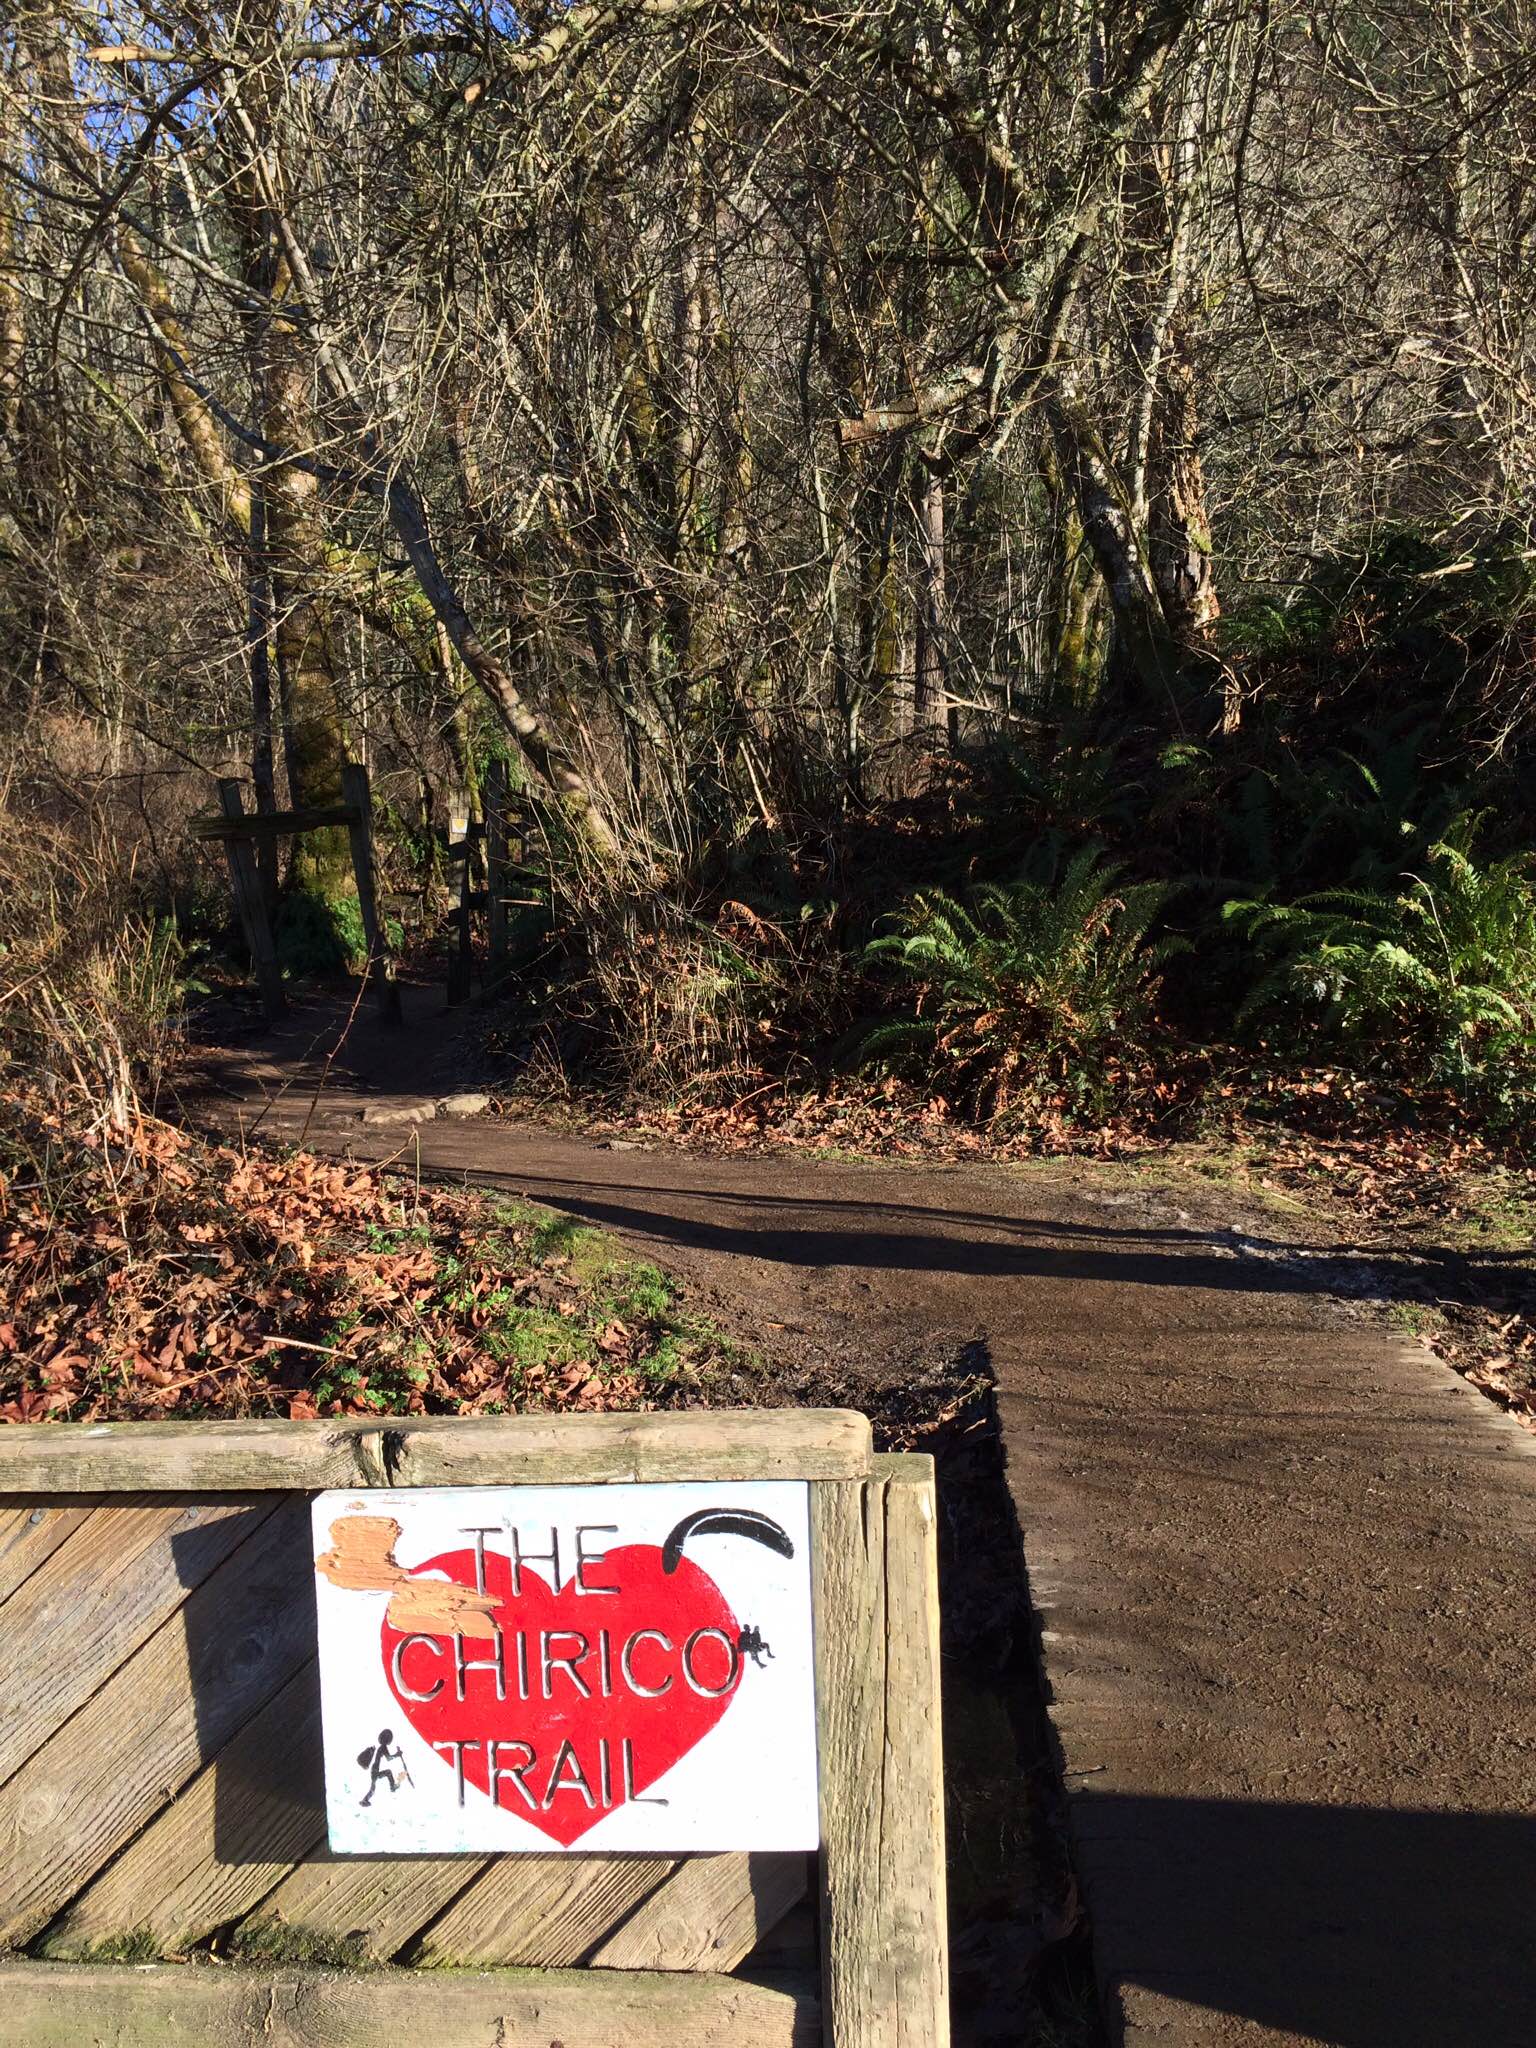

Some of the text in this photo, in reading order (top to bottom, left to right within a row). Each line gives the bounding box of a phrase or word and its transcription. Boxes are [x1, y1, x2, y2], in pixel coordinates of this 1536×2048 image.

[458, 1525, 622, 1597] THE
[391, 1627, 740, 1702] CHIRICO
[432, 1737, 670, 1809] TRAIL
